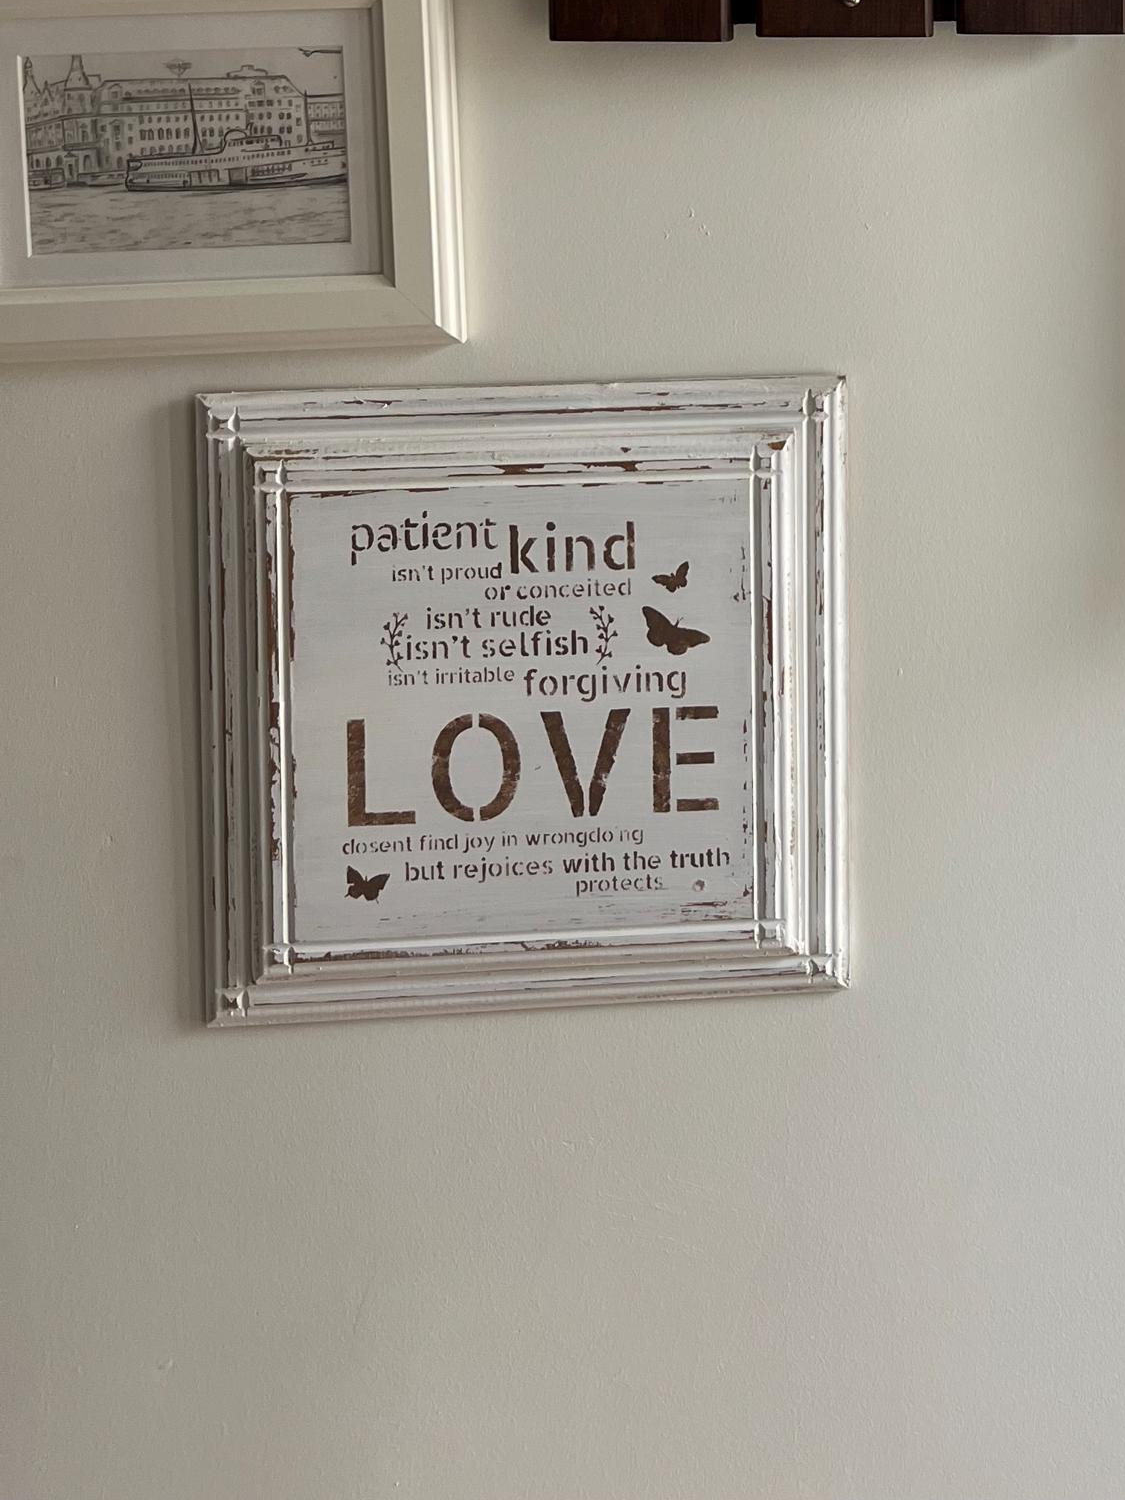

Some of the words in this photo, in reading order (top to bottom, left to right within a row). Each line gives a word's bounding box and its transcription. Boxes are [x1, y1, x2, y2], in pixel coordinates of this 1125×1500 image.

[351, 511, 498, 565] patient
[509, 521, 635, 574] kind
[392, 566, 433, 582] isn't
[441, 562, 502, 583] proud
[485, 584, 510, 601] or
[516, 578, 631, 599] conceited
[427, 607, 481, 629] isn't
[490, 606, 551, 627] rude
[406, 635, 471, 660] isn't
[482, 629, 588, 658] selfish
[388, 670, 428, 686] isn't
[435, 667, 515, 685] irritable
[523, 664, 687, 701] forgiving
[347, 706, 719, 827] LOVE
[342, 836, 412, 855] dosent
[420, 833, 458, 852] find
[463, 833, 494, 853] joy
[502, 831, 517, 846] in
[525, 826, 644, 847] wrongdong
[405, 861, 444, 882] but
[453, 857, 553, 883] rejoices
[563, 853, 616, 873] with
[623, 851, 661, 870] the
[670, 847, 730, 868] truth
[576, 874, 664, 897] protects
